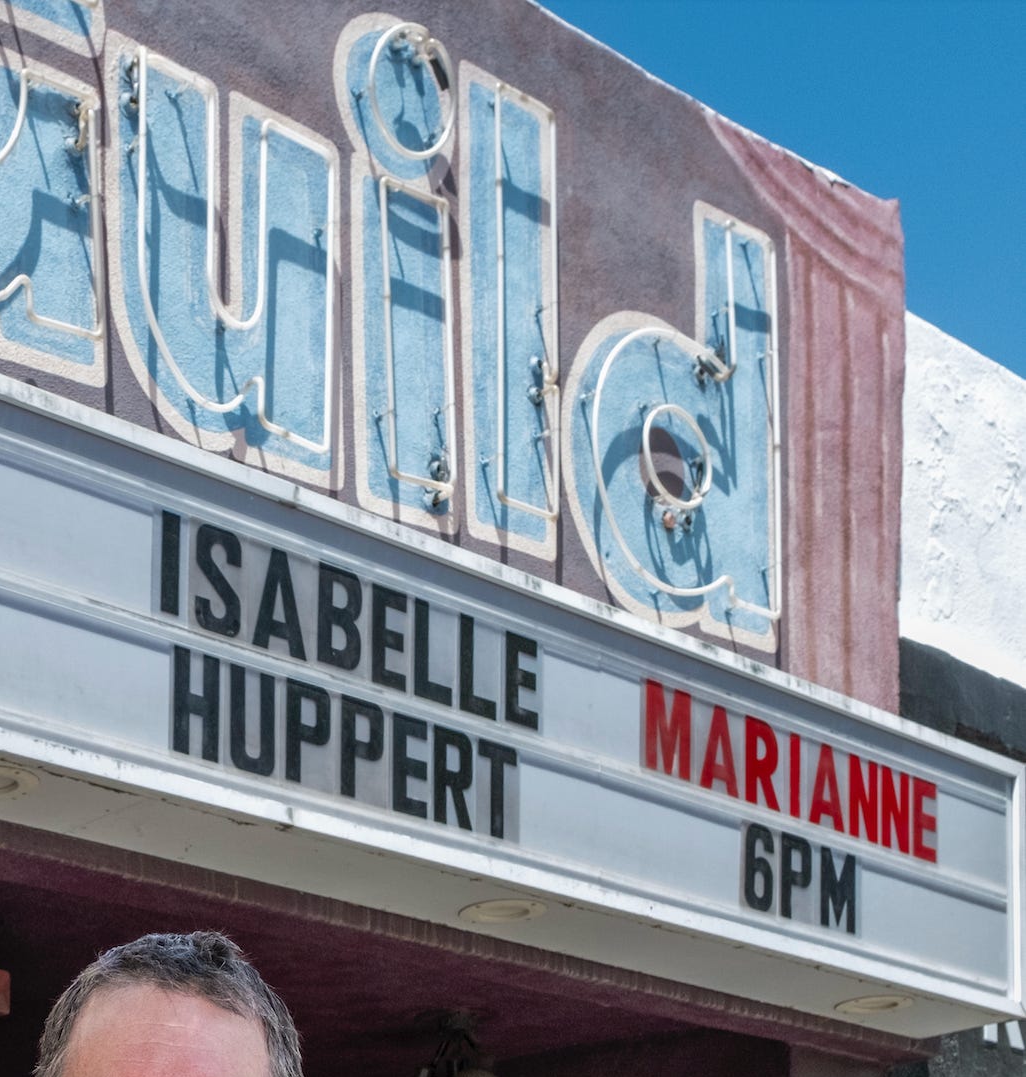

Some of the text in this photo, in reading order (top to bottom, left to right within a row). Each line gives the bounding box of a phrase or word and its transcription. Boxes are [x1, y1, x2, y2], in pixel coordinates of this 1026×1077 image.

[160, 509, 937, 864] ISABELLE MARIANNE
[177, 647, 856, 934] HUPPERT 6PM
